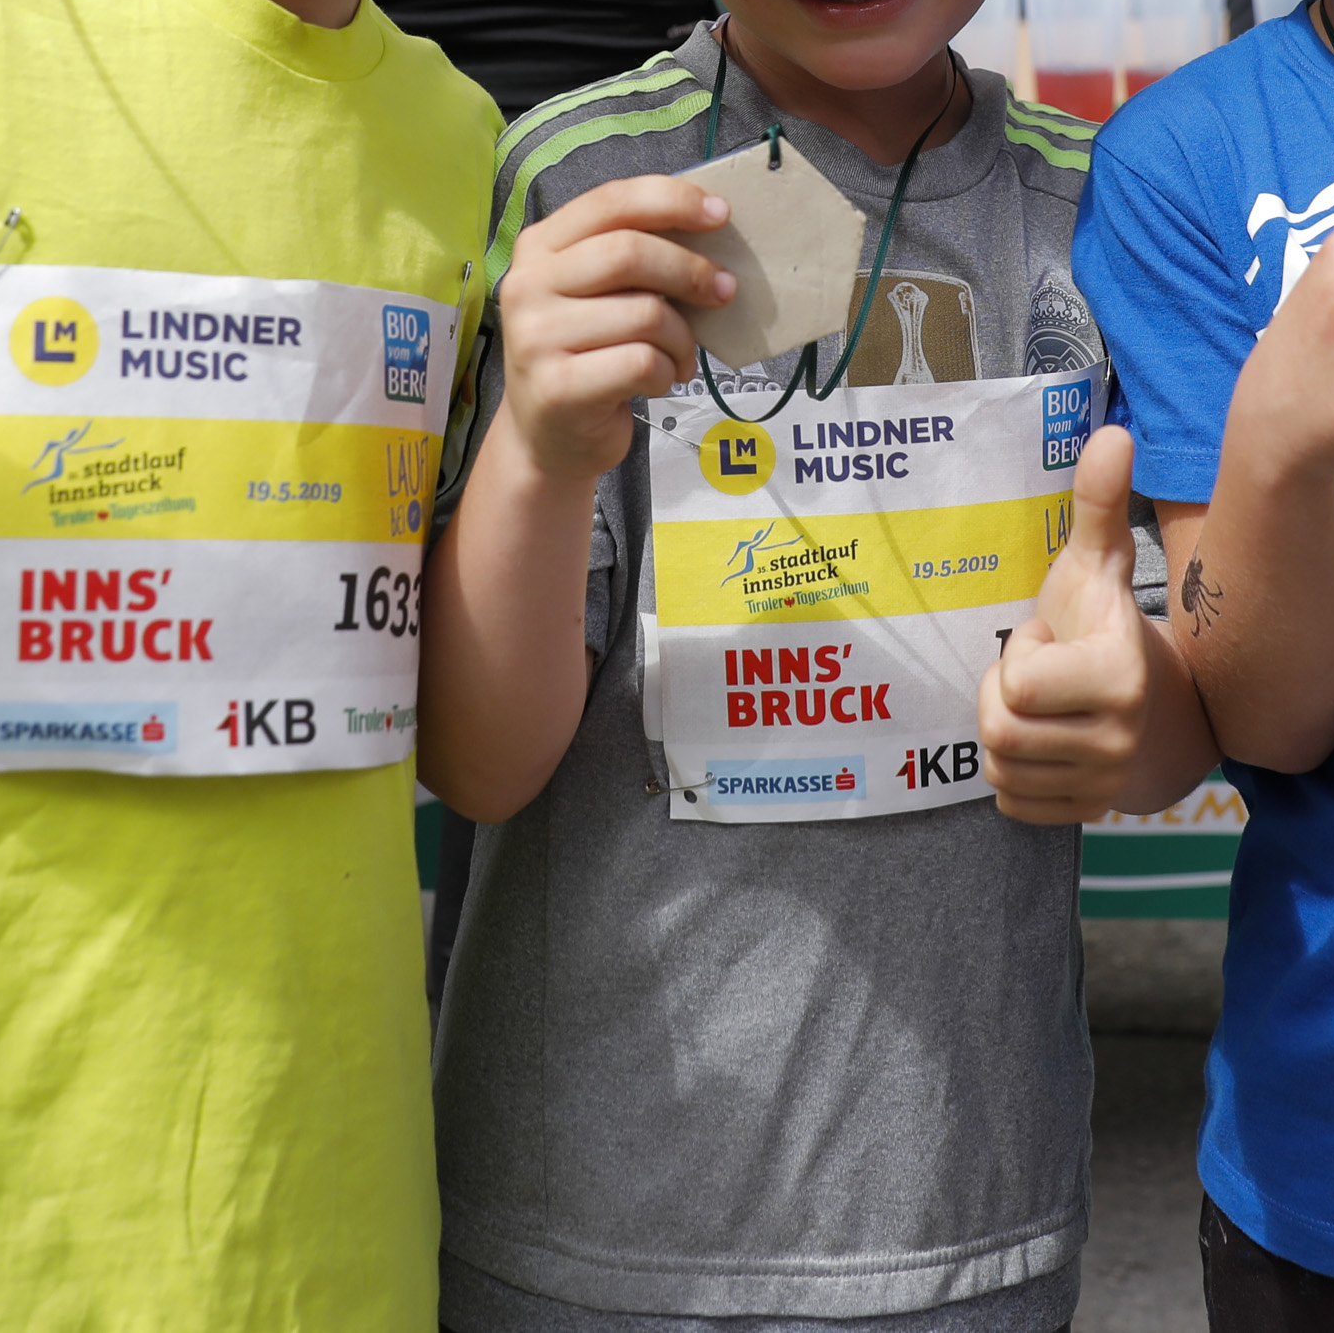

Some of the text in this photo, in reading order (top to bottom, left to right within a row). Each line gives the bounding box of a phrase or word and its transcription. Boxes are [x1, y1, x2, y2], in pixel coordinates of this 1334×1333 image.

[121, 309, 302, 346] LINDNER
[386, 311, 417, 342] BIO
[120, 350, 249, 381] MUSIC
[388, 346, 410, 361] vom
[1047, 388, 1080, 417] BIO
[794, 416, 954, 450] LINDNER
[1047, 419, 1072, 435] vom
[84, 447, 186, 479] stadtlauf
[794, 451, 910, 485] MUSIC
[49, 473, 162, 505] innsbruck
[246, 480, 342, 503] 19.5.2019
[770, 539, 858, 572] stadtlauf
[912, 555, 998, 579] 19.5.2019
[743, 563, 839, 595] innsbruck
[746, 581, 869, 614] Tiroler Tageszeitung
[18, 619, 213, 662] BRUCK
[727, 683, 891, 728] BRUCK
[717, 774, 833, 795] SPARKASSE
